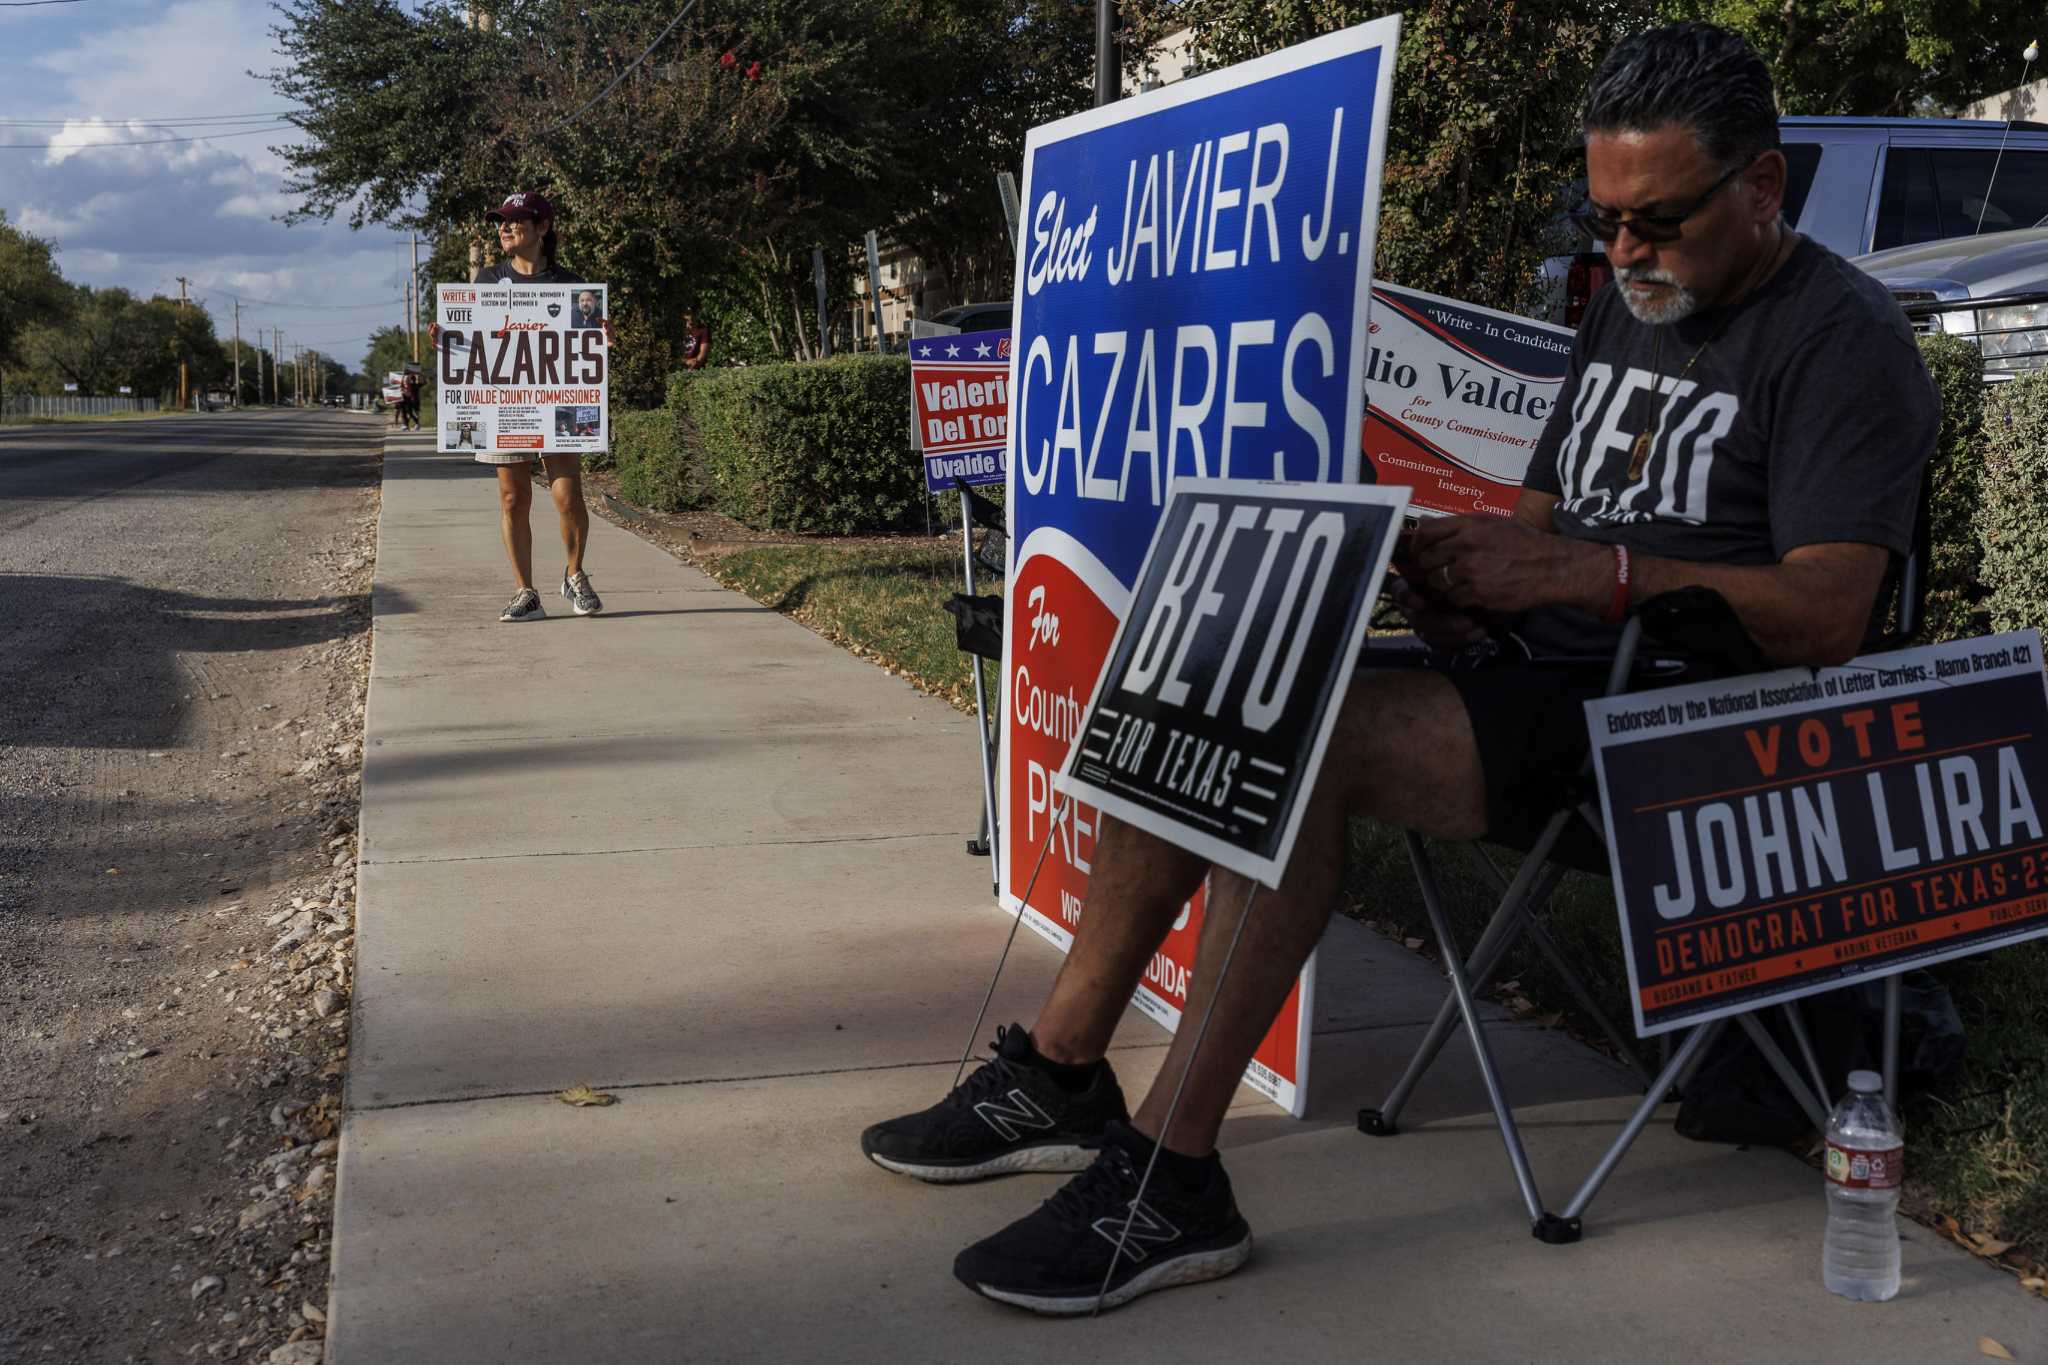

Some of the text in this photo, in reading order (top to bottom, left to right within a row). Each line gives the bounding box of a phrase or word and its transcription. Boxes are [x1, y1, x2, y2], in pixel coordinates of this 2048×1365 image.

[1027, 107, 1349, 296] Elect JAVIER J.
[442, 290, 476, 302] WRITE IN
[446, 309, 472, 322] VOTE
[497, 315, 548, 337] Javier
[1485, 323, 1499, 338] In
[1504, 328, 1571, 355] Candidate
[442, 330, 604, 385] CAZARES
[1366, 347, 1417, 389] lio
[445, 389, 600, 404] FOR UVALDE COUNTY COMMISSIONER
[921, 376, 1009, 412] Valeri
[1021, 312, 1335, 506] CAZARES
[1409, 395, 1432, 408] for
[928, 414, 1007, 443] Del Tor
[1401, 409, 1444, 428] County
[1447, 419, 1527, 446] Commissioner
[930, 453, 995, 480] Uvalde
[1378, 452, 1453, 478] Commitment
[1438, 479, 1485, 499] Integrity
[1473, 500, 1514, 517] Comm
[1028, 585, 1060, 651] For
[1121, 502, 1345, 732] BETO
[1607, 705, 1665, 734] Endorsed
[1668, 703, 1684, 725] by
[1686, 700, 1707, 720] the
[1708, 690, 1759, 717] National
[1759, 681, 1823, 708] Association
[1825, 679, 1838, 698] of
[1839, 674, 1876, 694] Letter
[1935, 658, 1970, 679] Alamo
[1971, 649, 2012, 673] Branch
[2012, 645, 2032, 664] 421
[1744, 700, 1926, 777] VOTE
[1105, 714, 1152, 776] FOR
[1155, 728, 1241, 808] TEXAS
[1028, 759, 1101, 875] PRE
[1653, 745, 2043, 920] JOHN LIRA
[1989, 903, 2022, 921] PUBLIC
[1655, 903, 1824, 977] DEMOCRAT
[1842, 886, 1898, 932] FOR
[1833, 939, 1872, 960] MARINE
[1875, 928, 1919, 953] VETERAN
[1145, 952, 1192, 1002] DIDA
[1653, 981, 1701, 1002] HUSBAND
[1719, 967, 1758, 989] FATHER
